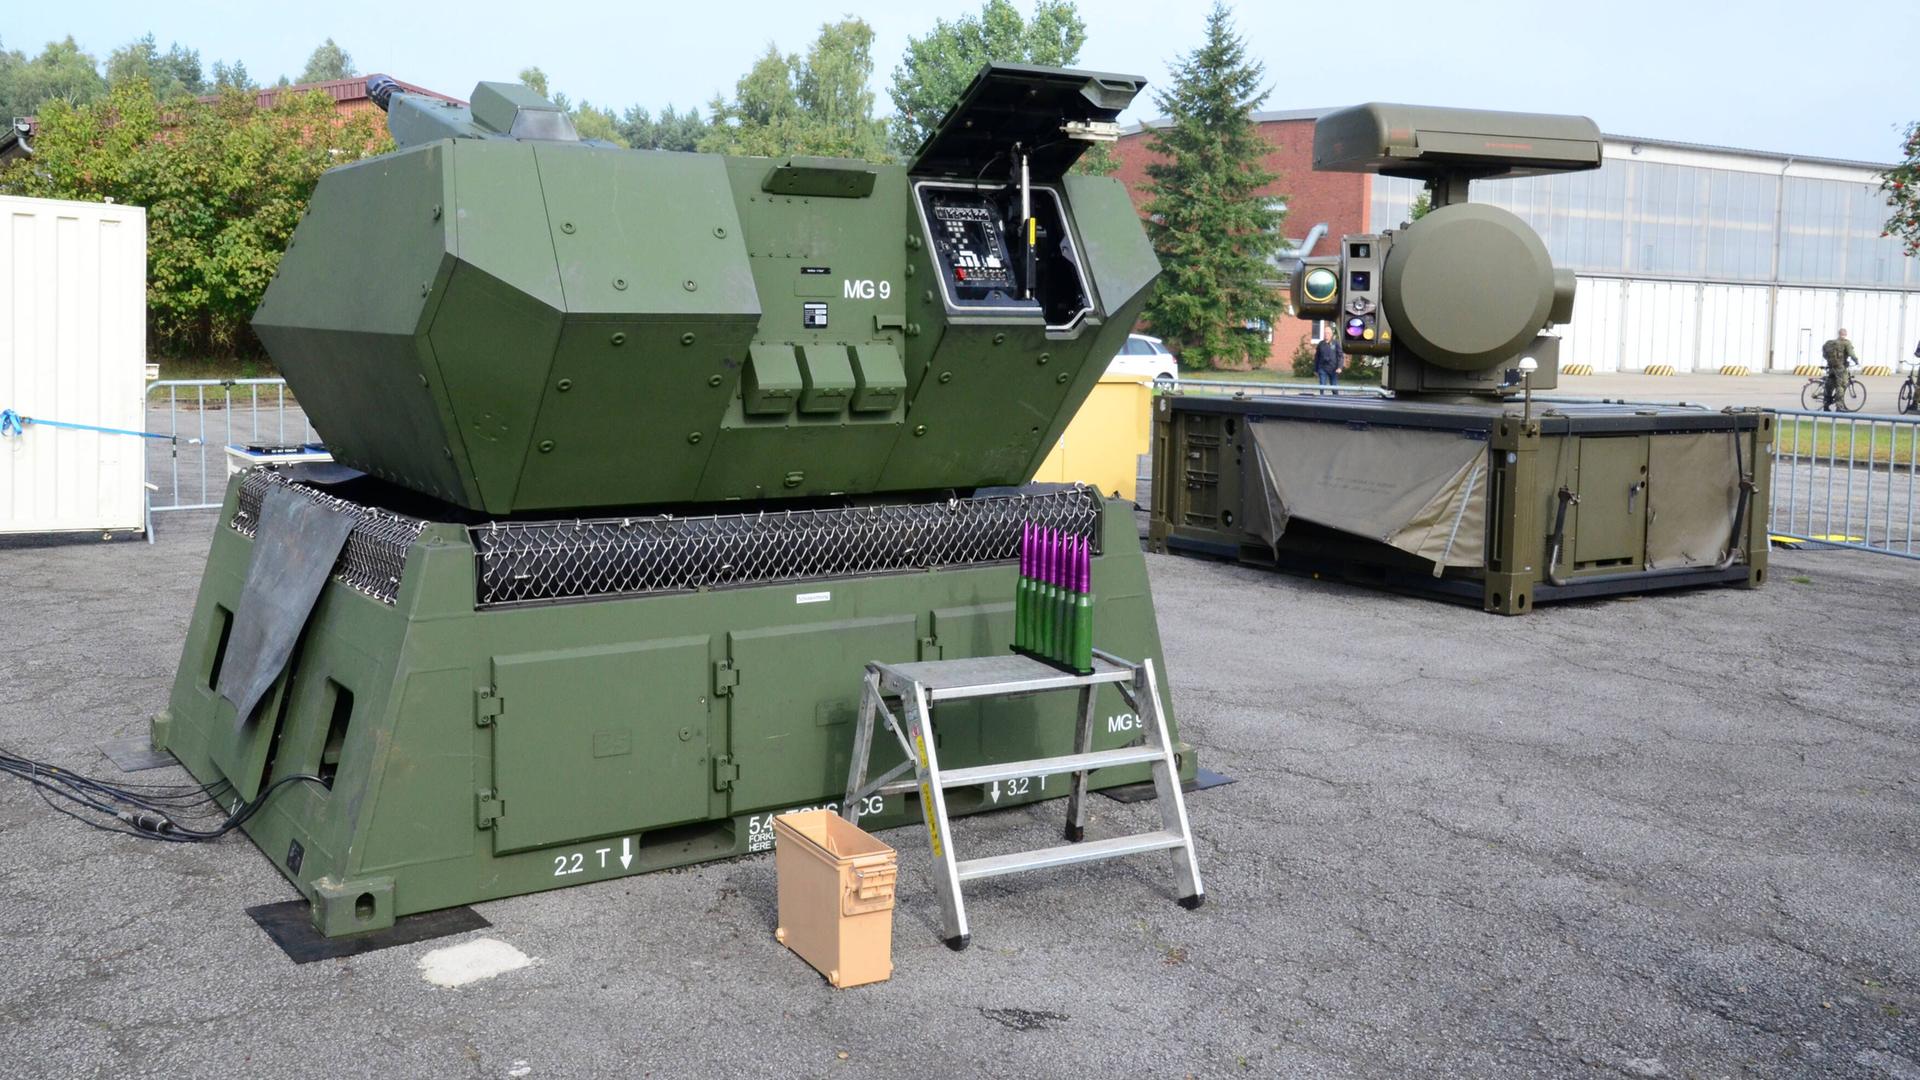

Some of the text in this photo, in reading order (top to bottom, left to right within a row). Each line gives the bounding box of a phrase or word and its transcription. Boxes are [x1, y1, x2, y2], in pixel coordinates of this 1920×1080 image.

[844, 280, 891, 299] MG 9
[1108, 713, 1132, 733] MG
[1007, 775, 1049, 796] 3.2 T
[748, 832, 777, 844] FORKL
[748, 841, 771, 852] HERE
[554, 848, 611, 876] 2.2 T
